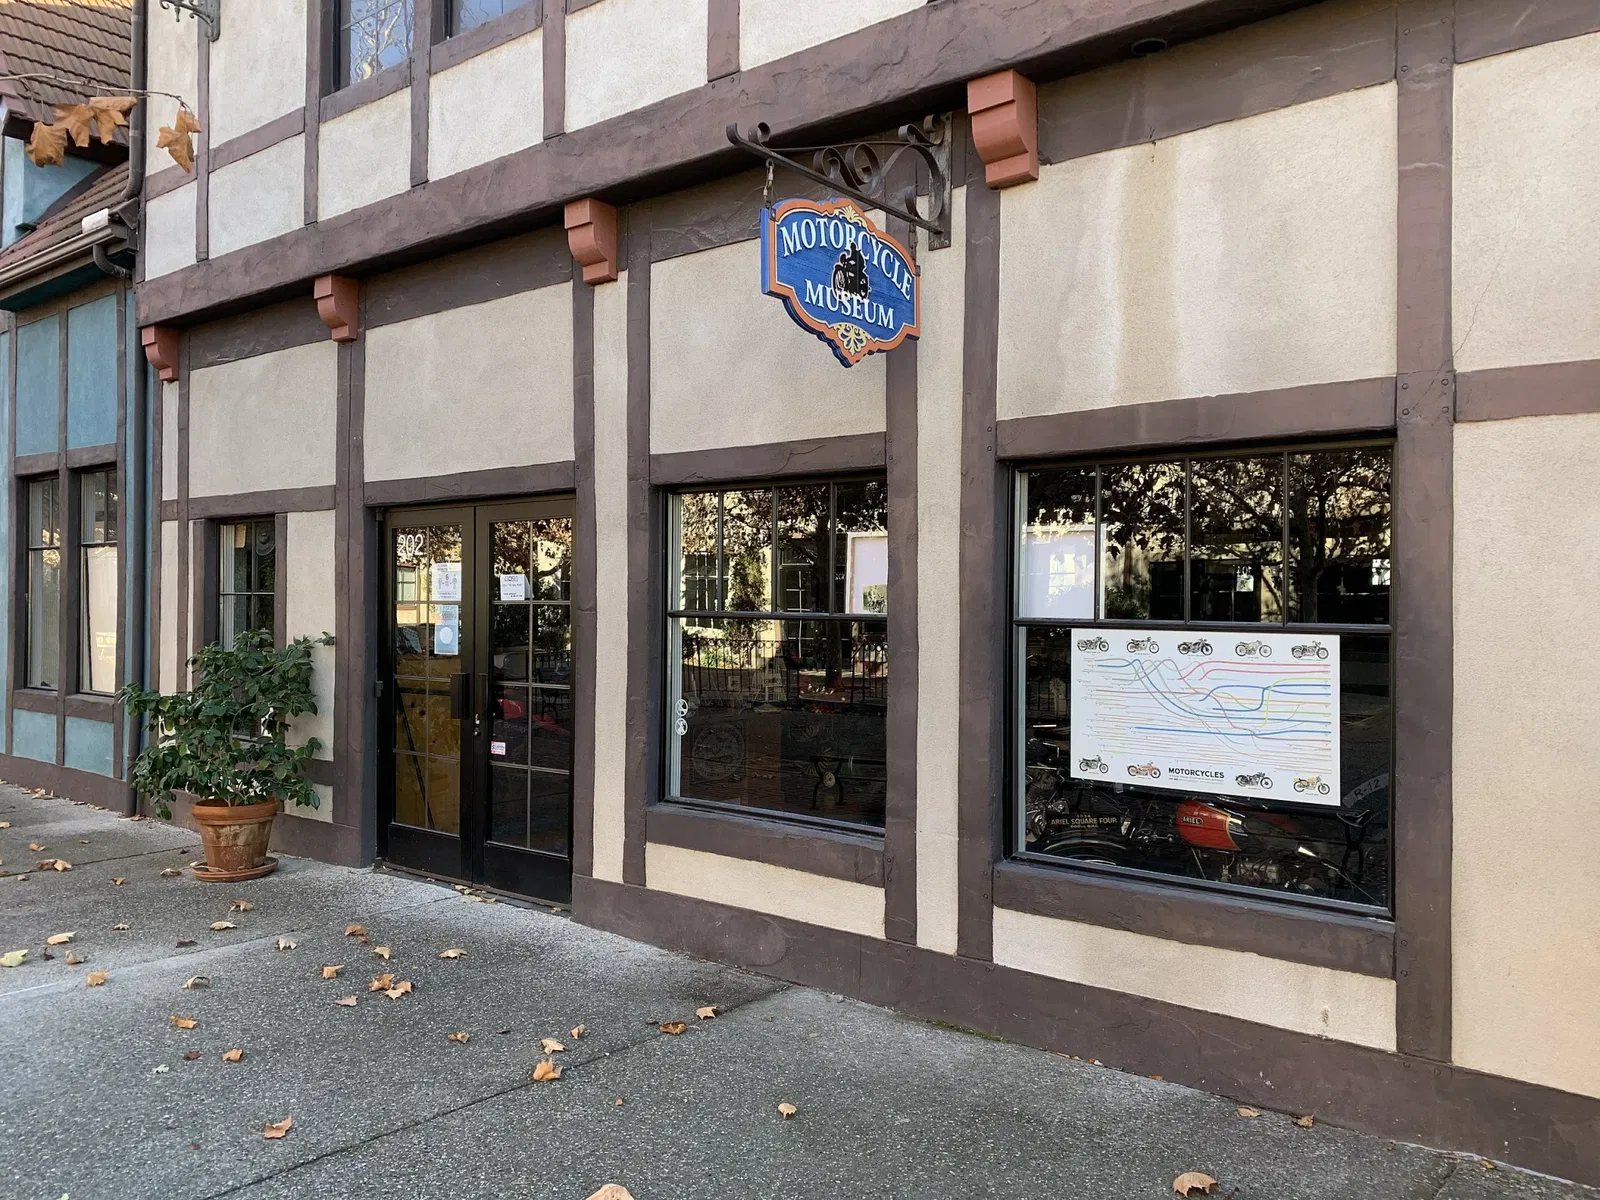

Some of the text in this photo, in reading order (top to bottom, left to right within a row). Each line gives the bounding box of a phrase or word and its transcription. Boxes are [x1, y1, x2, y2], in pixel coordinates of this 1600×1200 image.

[780, 218, 912, 299] MOTORCYCLE
[805, 279, 894, 330] MUSEUM
[398, 534, 423, 556] 202
[1168, 767, 1225, 779] MOTORCYCLES
[1071, 817, 1098, 825] SQUARE
